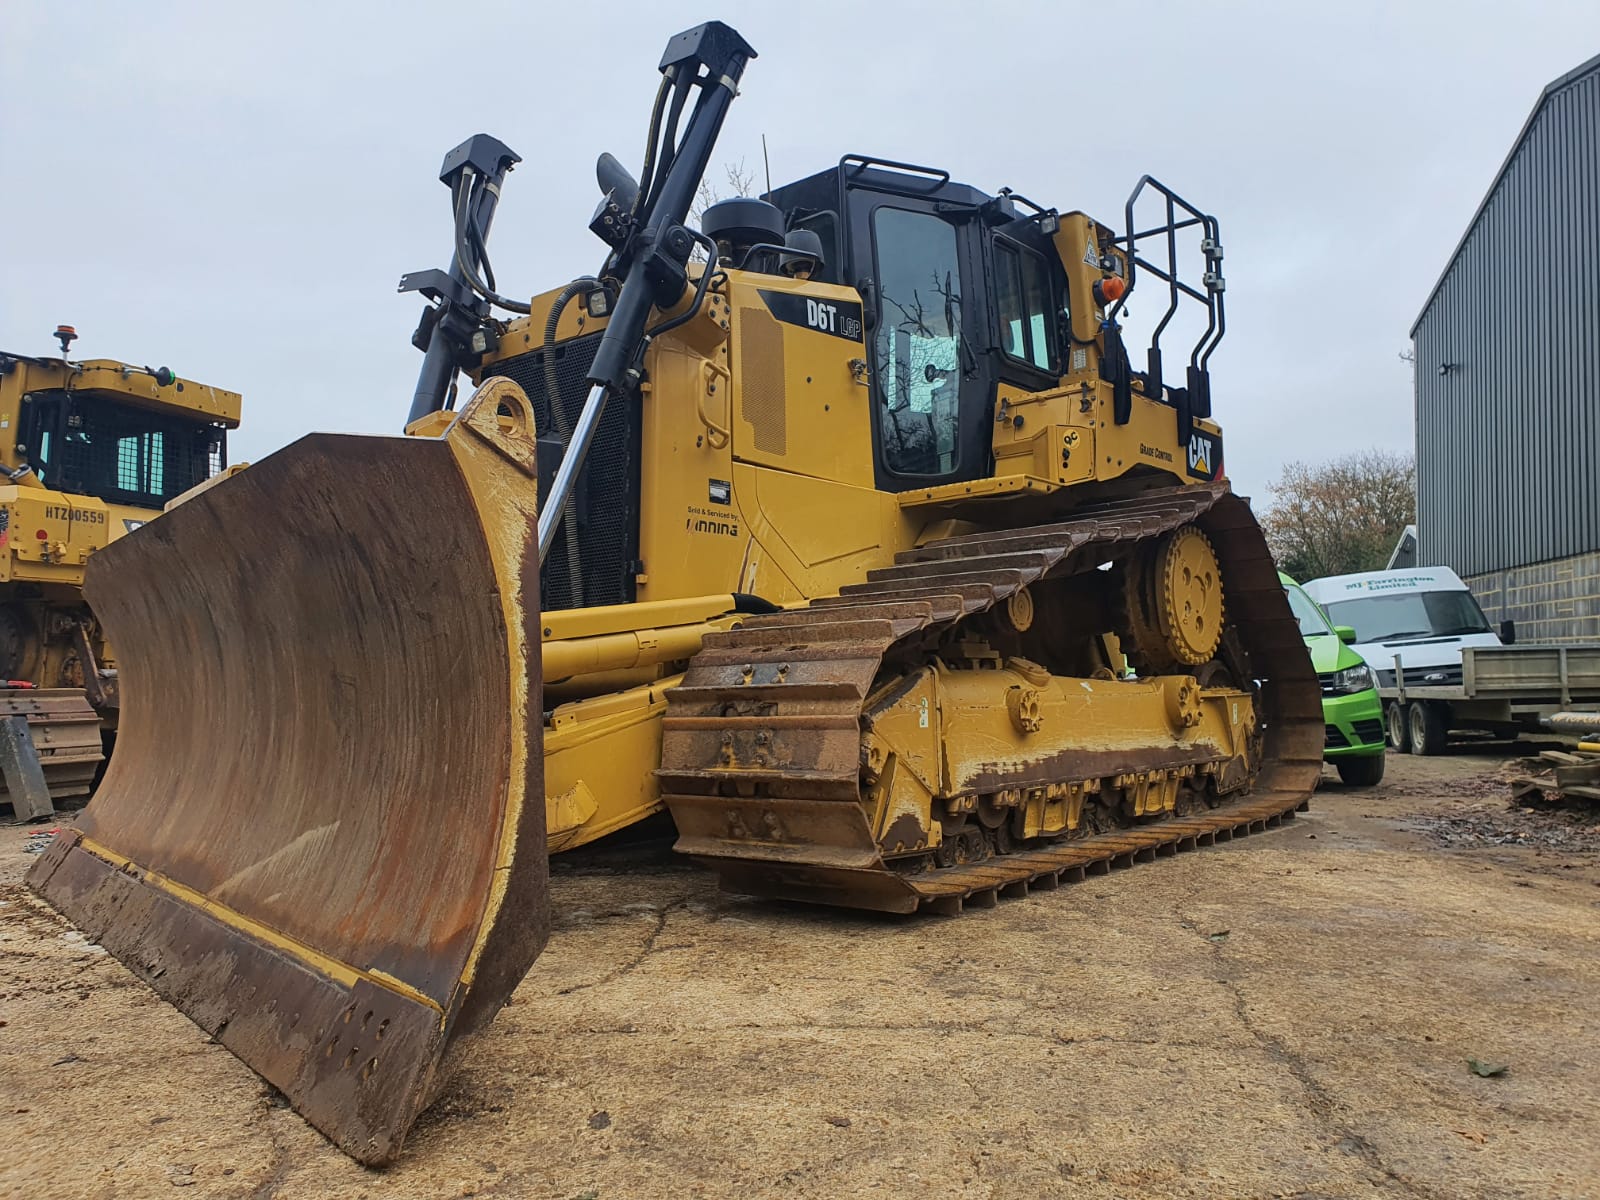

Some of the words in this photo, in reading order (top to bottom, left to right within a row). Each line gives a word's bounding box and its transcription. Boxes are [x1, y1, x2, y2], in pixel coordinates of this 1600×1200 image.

[807, 298, 836, 332] D6T
[840, 315, 860, 338] LGP
[1189, 434, 1211, 475] CAT
[46, 506, 104, 524] HTZ00559
